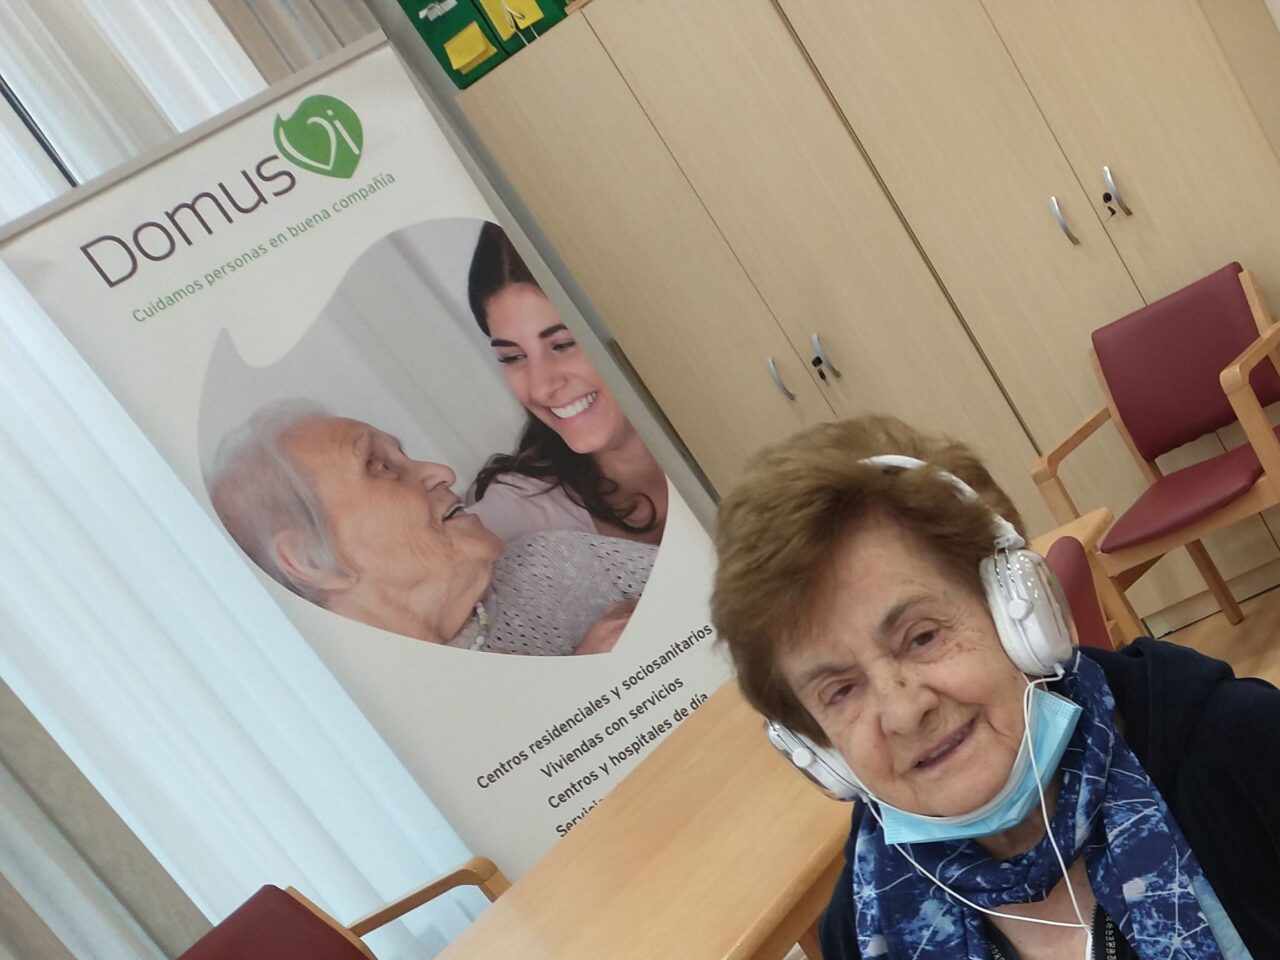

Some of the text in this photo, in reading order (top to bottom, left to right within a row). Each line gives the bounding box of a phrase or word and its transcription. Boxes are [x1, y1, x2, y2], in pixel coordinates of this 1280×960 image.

[132, 172, 396, 322] Cuidamos personas en buena compañía
[476, 623, 713, 789] Centros residenciales y sociosanitarios
[539, 676, 684, 779] Viviendas con servicios
[547, 768, 599, 809] Centros
[599, 762, 611, 776] y
[610, 717, 673, 767] hospitales
[673, 705, 689, 722] de
